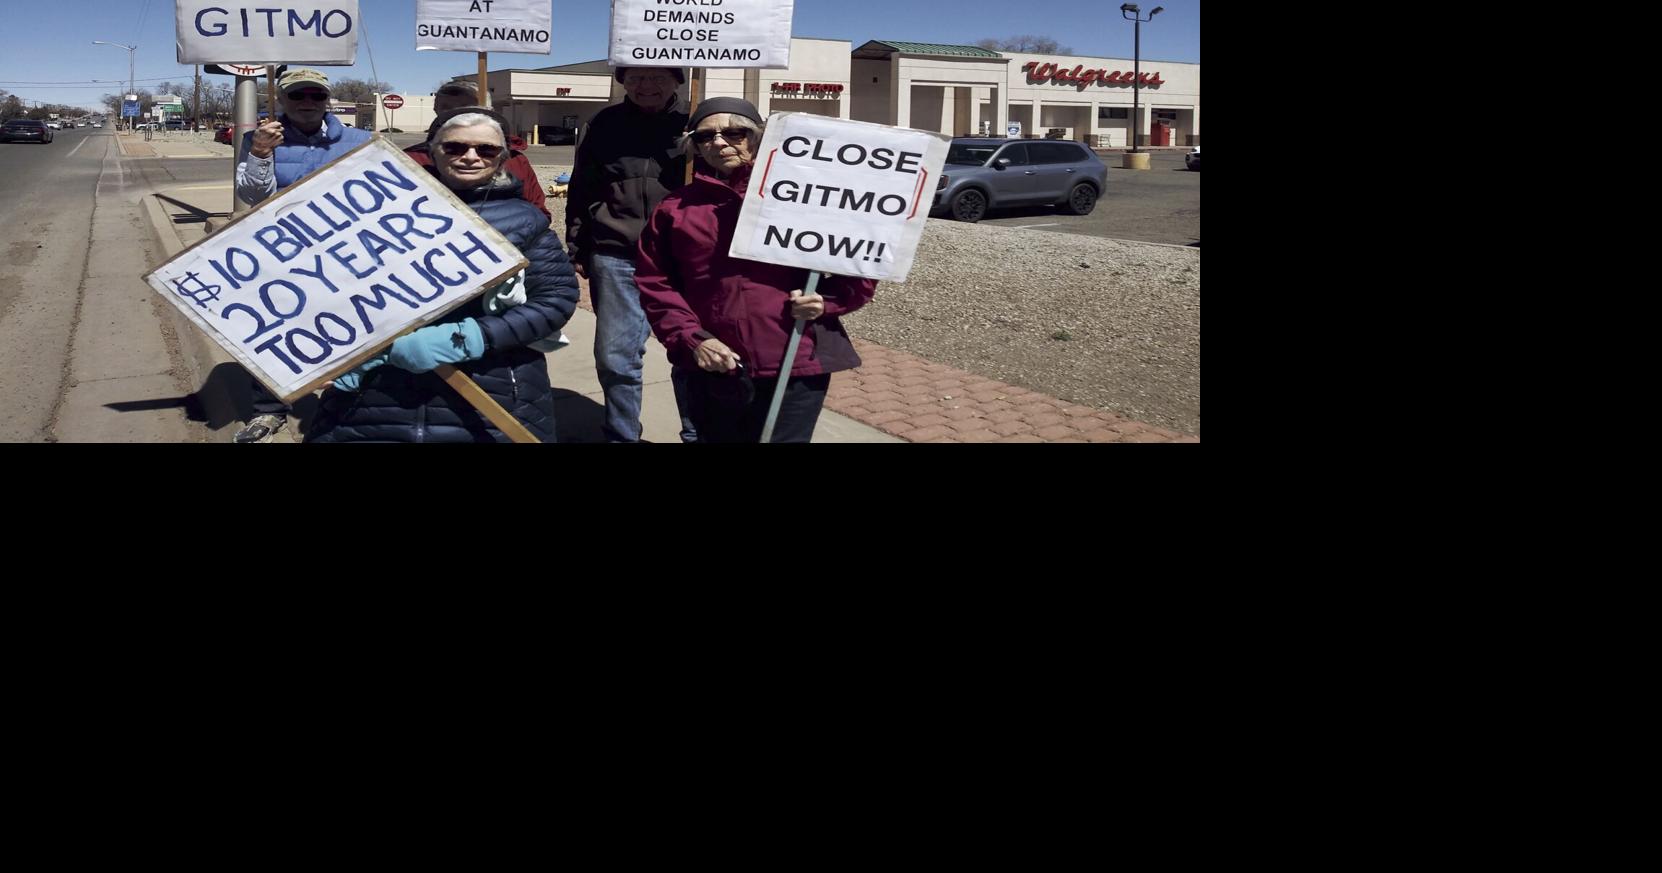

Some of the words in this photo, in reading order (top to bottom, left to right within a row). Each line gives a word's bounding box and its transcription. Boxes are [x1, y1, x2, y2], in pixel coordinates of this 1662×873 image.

[469, 0, 493, 13] AT
[643, 10, 735, 25] DEMANDS
[195, 7, 352, 38] GITMO
[418, 24, 549, 43] GUANTANAMO
[656, 28, 719, 42] CLOSE
[632, 47, 761, 61] GUANTANAMO
[1025, 61, 1165, 88] Walgreens
[782, 136, 922, 174] CLOSE
[253, 160, 418, 262] BILLION
[771, 180, 907, 216] GITMO
[763, 224, 886, 263] NOW!!
[221, 279, 306, 343] 20
[290, 195, 453, 293] YEARS
[254, 312, 356, 374] TOO
[350, 230, 502, 334] MUCH
